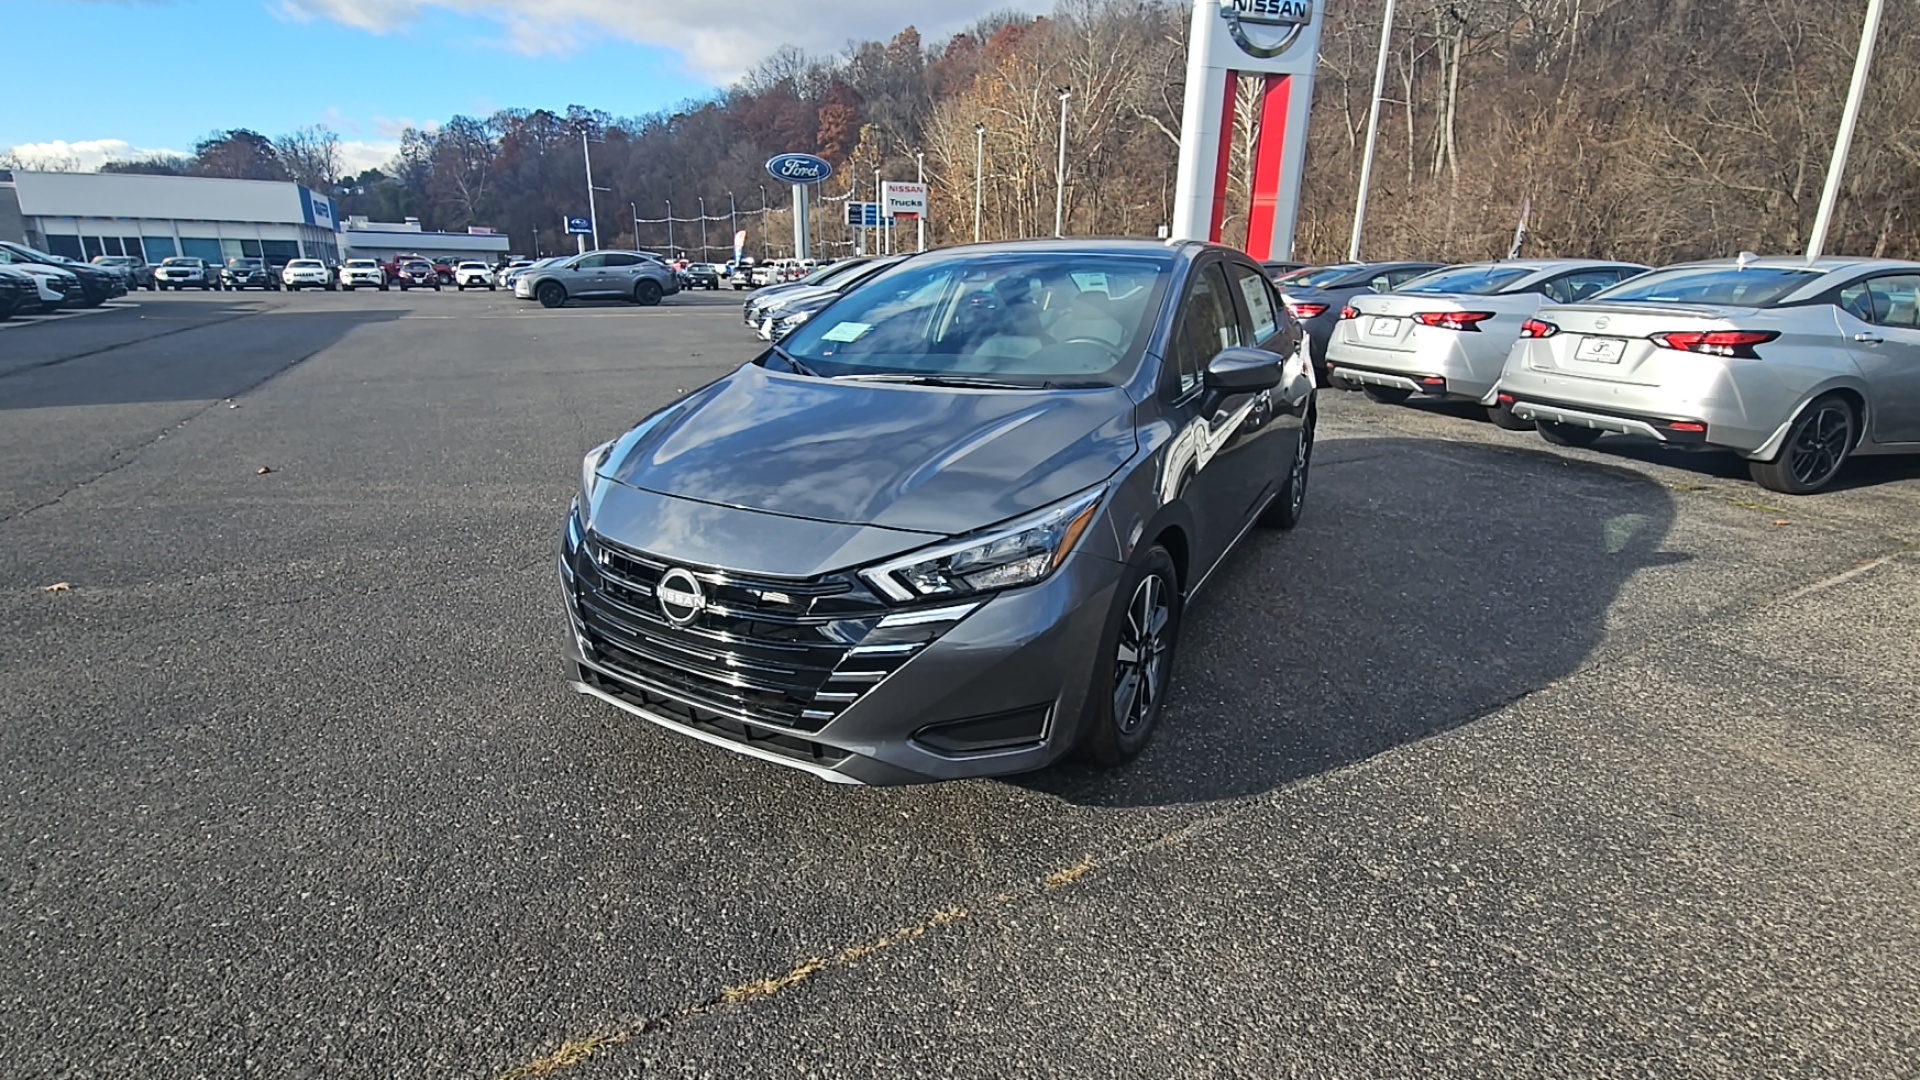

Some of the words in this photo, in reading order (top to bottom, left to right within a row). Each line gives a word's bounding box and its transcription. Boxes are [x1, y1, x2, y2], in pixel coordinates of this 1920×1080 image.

[1232, 0, 1306, 18] NISSAN
[781, 159, 819, 176] Ford
[889, 185, 923, 193] NISSAN
[890, 198, 922, 207] Trucks
[656, 585, 706, 609] NISSAN
